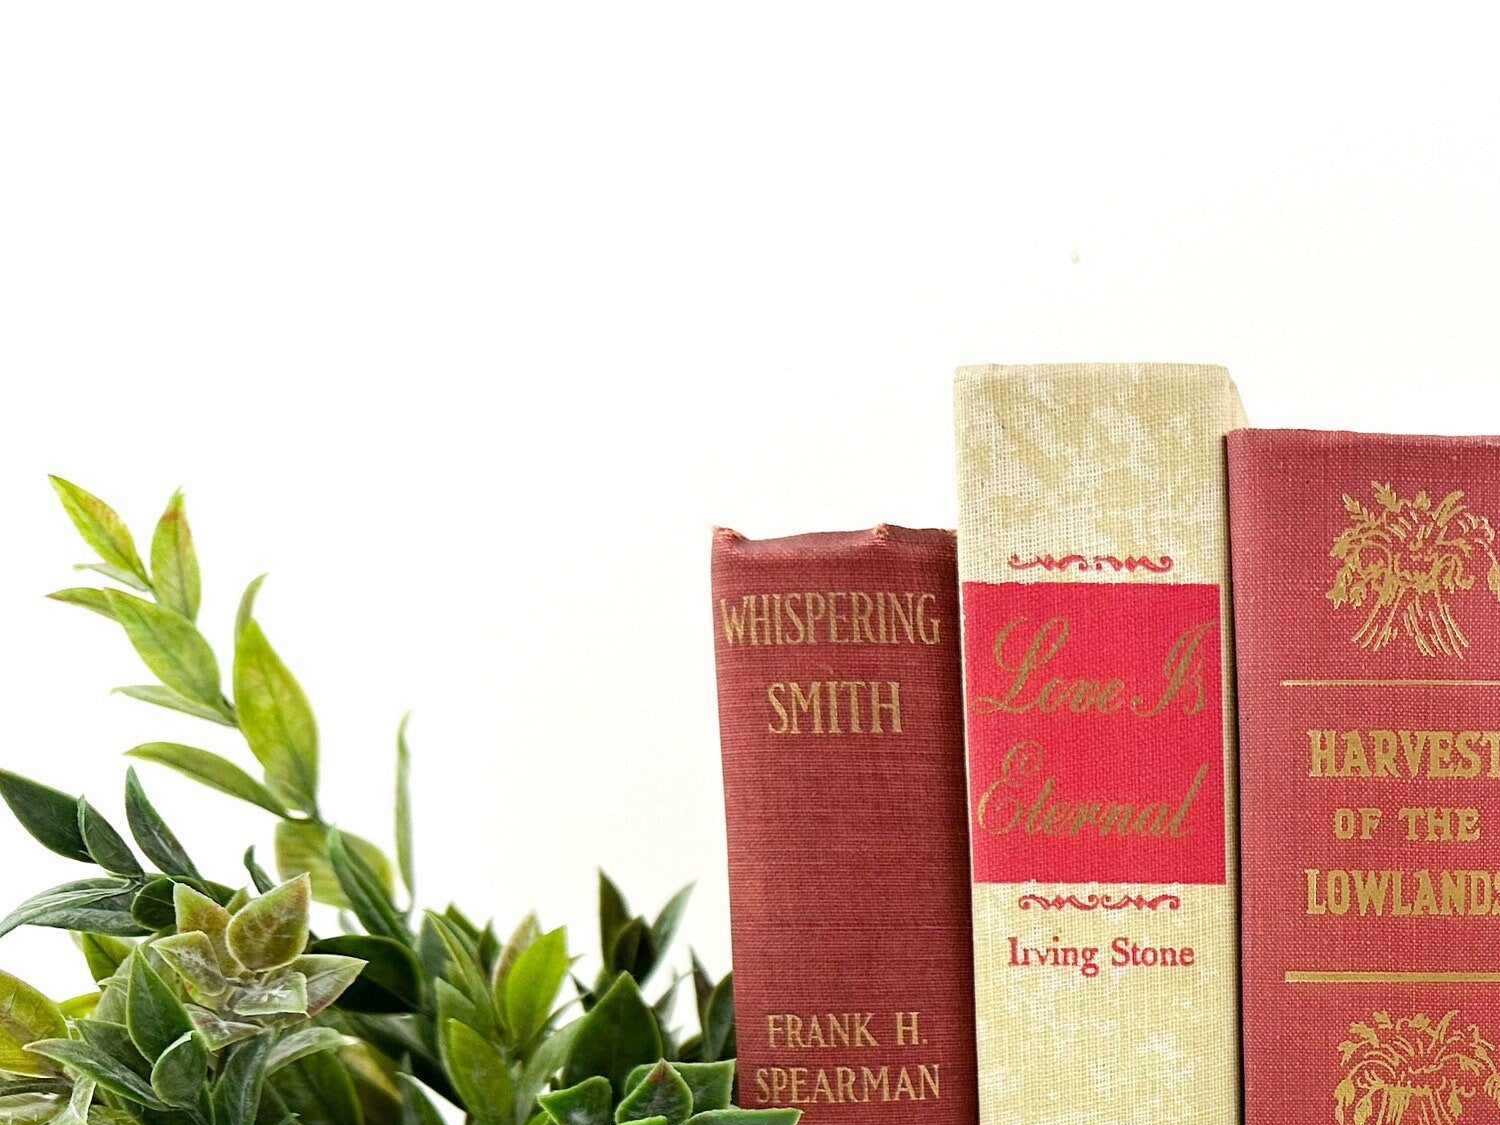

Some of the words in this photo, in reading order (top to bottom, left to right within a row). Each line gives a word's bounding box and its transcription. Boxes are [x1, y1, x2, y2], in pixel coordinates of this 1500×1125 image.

[720, 591, 942, 646] WHISPERING
[971, 616, 1126, 716] Love
[1131, 618, 1218, 718] Is
[767, 681, 903, 735] SMITH
[976, 739, 1209, 839] Eternal
[1333, 808, 1381, 841] OF
[1399, 808, 1481, 842] THE
[1007, 937, 1100, 976] Irving
[1111, 937, 1195, 968] Stone
[768, 1012, 877, 1048] FRANK
[896, 1011, 928, 1046] H.
[756, 1063, 941, 1104] SPEARMAN
